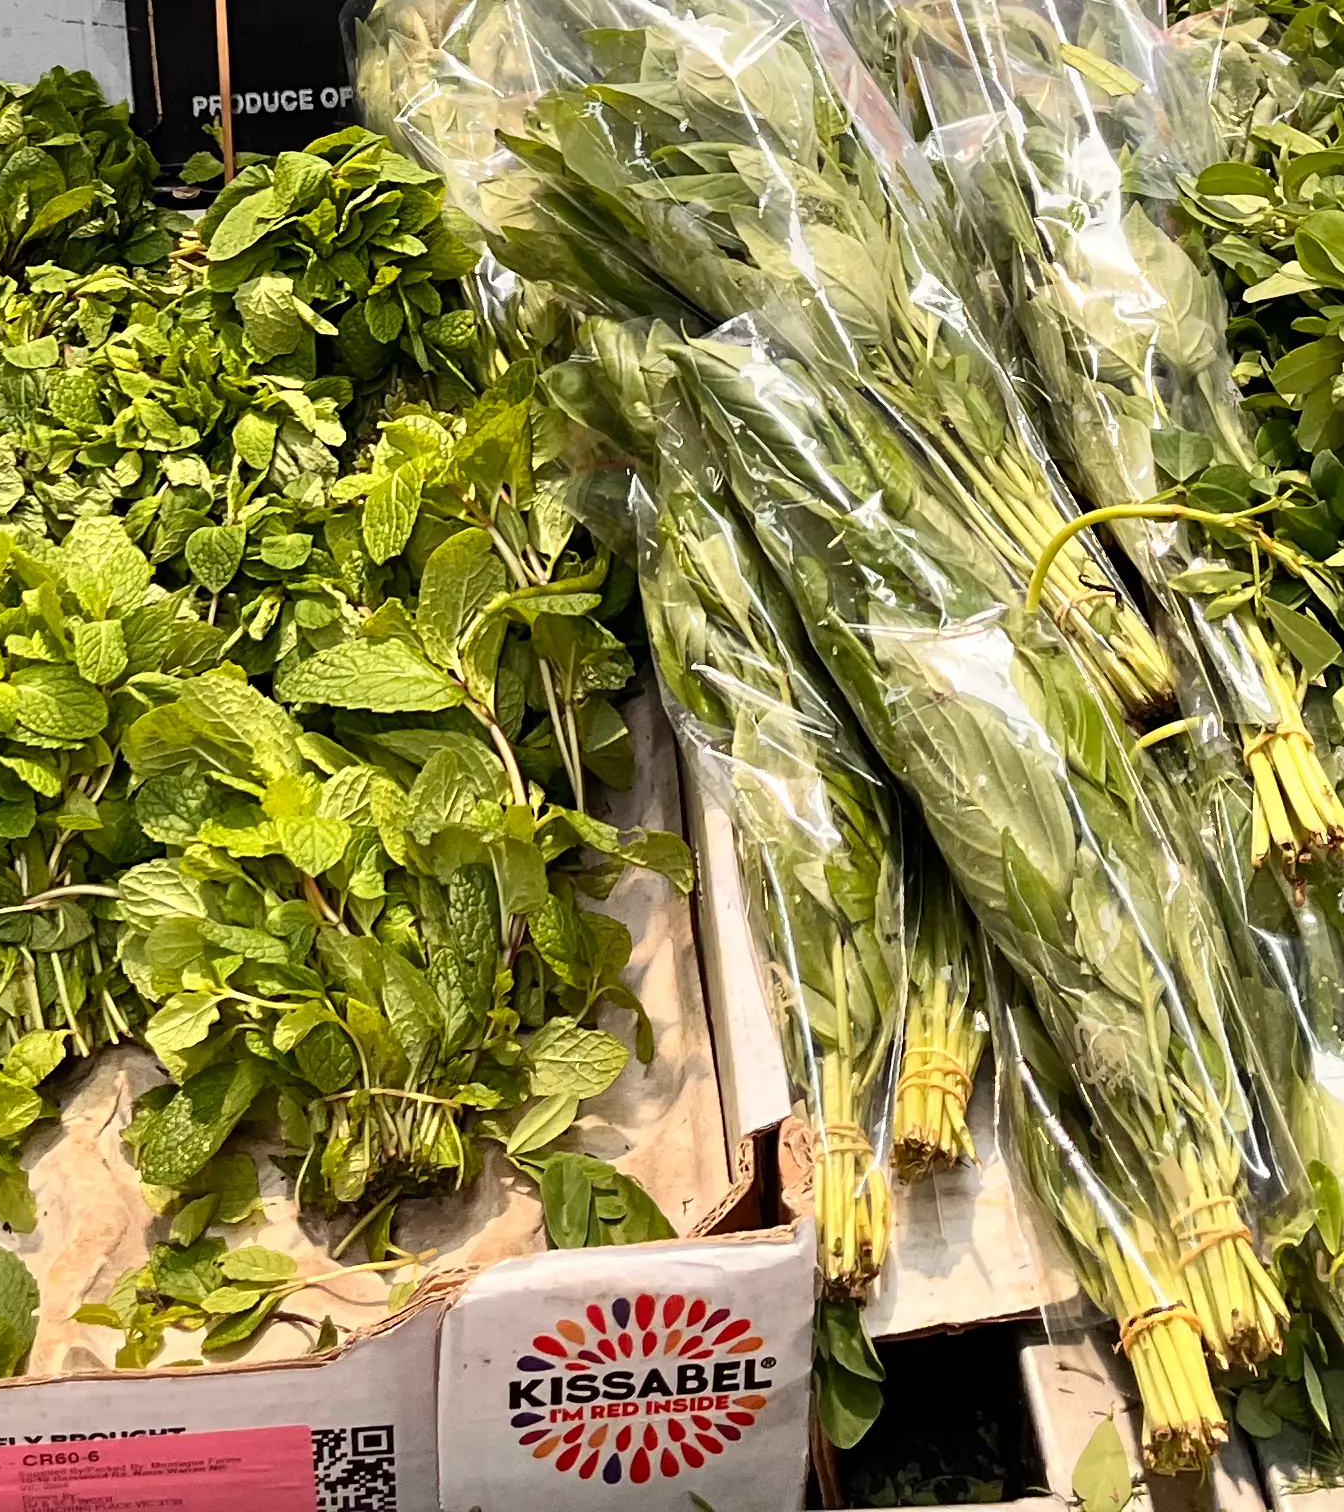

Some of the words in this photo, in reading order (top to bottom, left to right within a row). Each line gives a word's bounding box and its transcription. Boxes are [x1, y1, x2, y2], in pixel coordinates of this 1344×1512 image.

[192, 88, 314, 118] PRODUCE
[549, 1406, 586, 1424] I'M
[591, 1402, 640, 1420] RED
[646, 1395, 731, 1416] INSIDE
[22, 1450, 101, 1467] CR60-6
